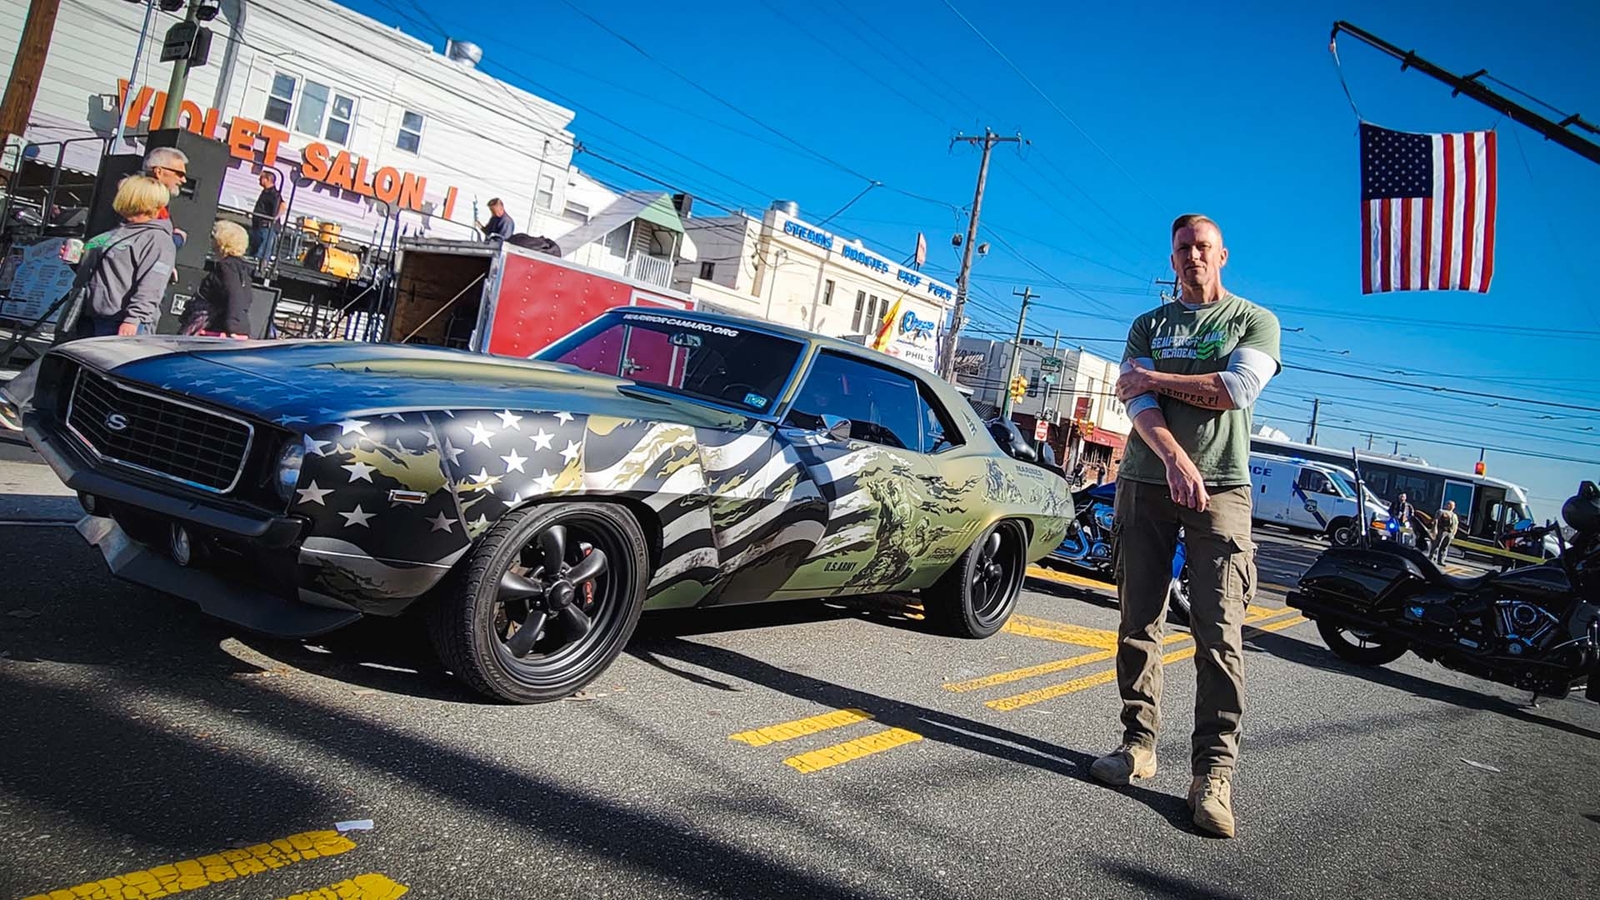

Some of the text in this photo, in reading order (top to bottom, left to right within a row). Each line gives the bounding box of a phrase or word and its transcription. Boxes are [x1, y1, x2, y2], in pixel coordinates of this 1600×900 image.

[117, 78, 290, 167] VIOLET
[302, 142, 428, 212] SALON
[622, 313, 740, 337] WARRIORCAMARO.ORG
[905, 350, 934, 363] PHIL'S
[1159, 387, 1220, 405] SEMPER FI
